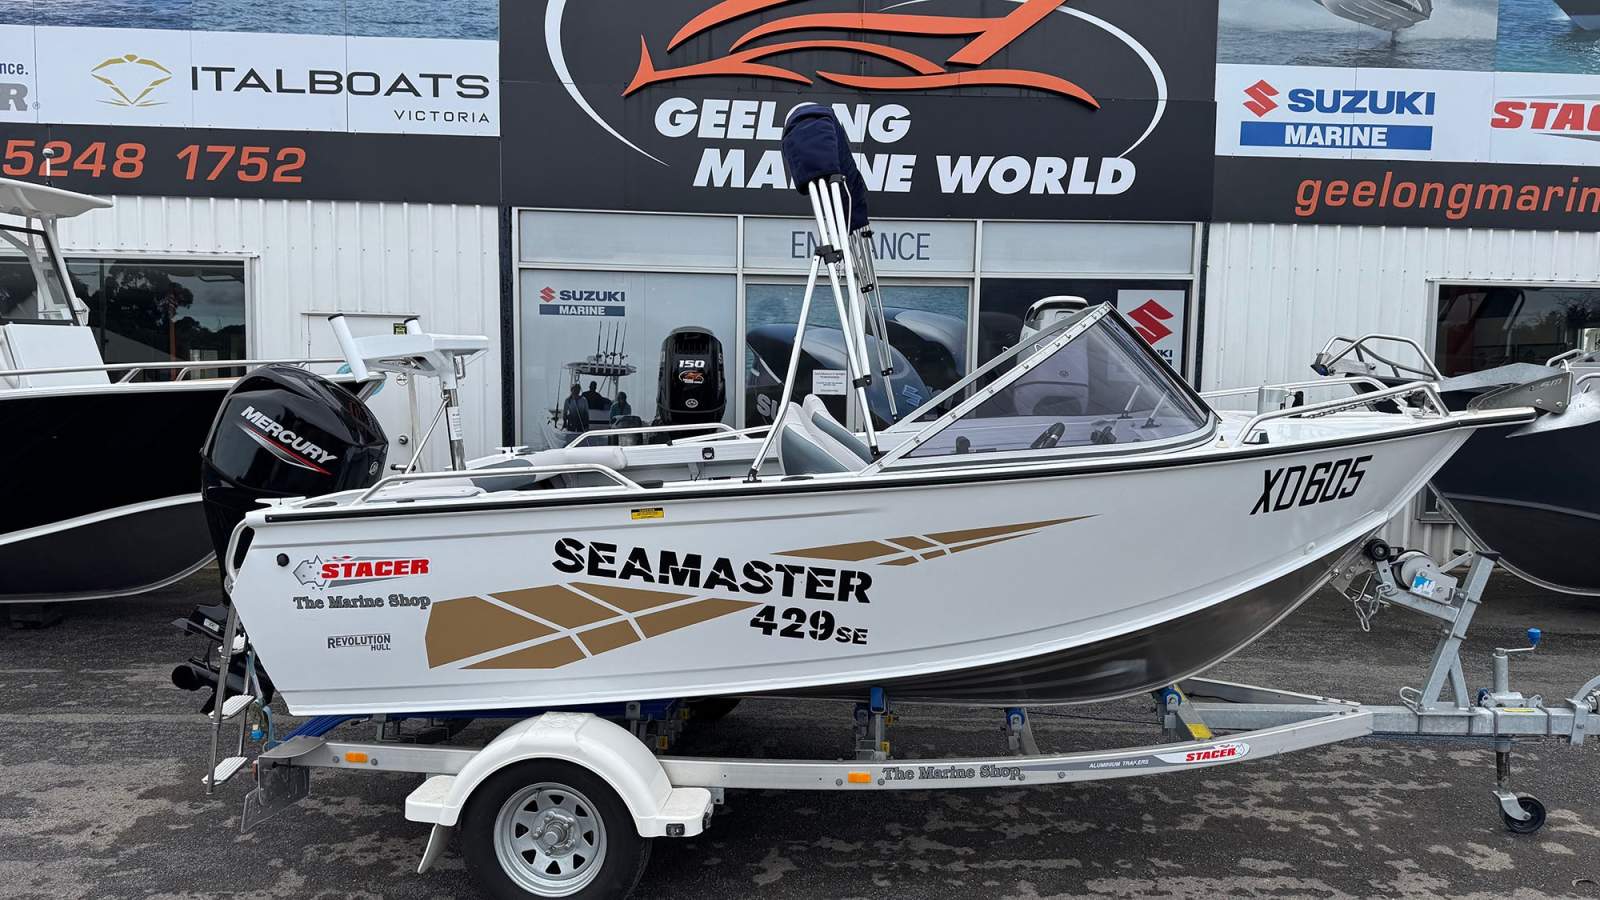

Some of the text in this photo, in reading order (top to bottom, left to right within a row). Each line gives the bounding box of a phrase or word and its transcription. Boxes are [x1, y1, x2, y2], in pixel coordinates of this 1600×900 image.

[191, 66, 490, 99] ITALBOATS
[1287, 88, 1436, 116] SUZUKI
[394, 109, 490, 123] VICTORIA
[1284, 125, 1388, 147] MARINE
[2, 139, 306, 183] 5248 1752
[693, 148, 1136, 195] MANE WORLD
[559, 290, 625, 302] SUZUKI
[559, 305, 606, 316] MARINE
[679, 360, 705, 368] 150
[240, 406, 338, 464] MERCURY
[321, 559, 430, 579] STACER
[552, 537, 873, 604] SEAMASTER
[293, 594, 431, 609] The Marine Shop
[328, 634, 391, 649] REVOLUTION
[1185, 747, 1236, 762] STACER
[883, 765, 1021, 780] The Marine Shop
